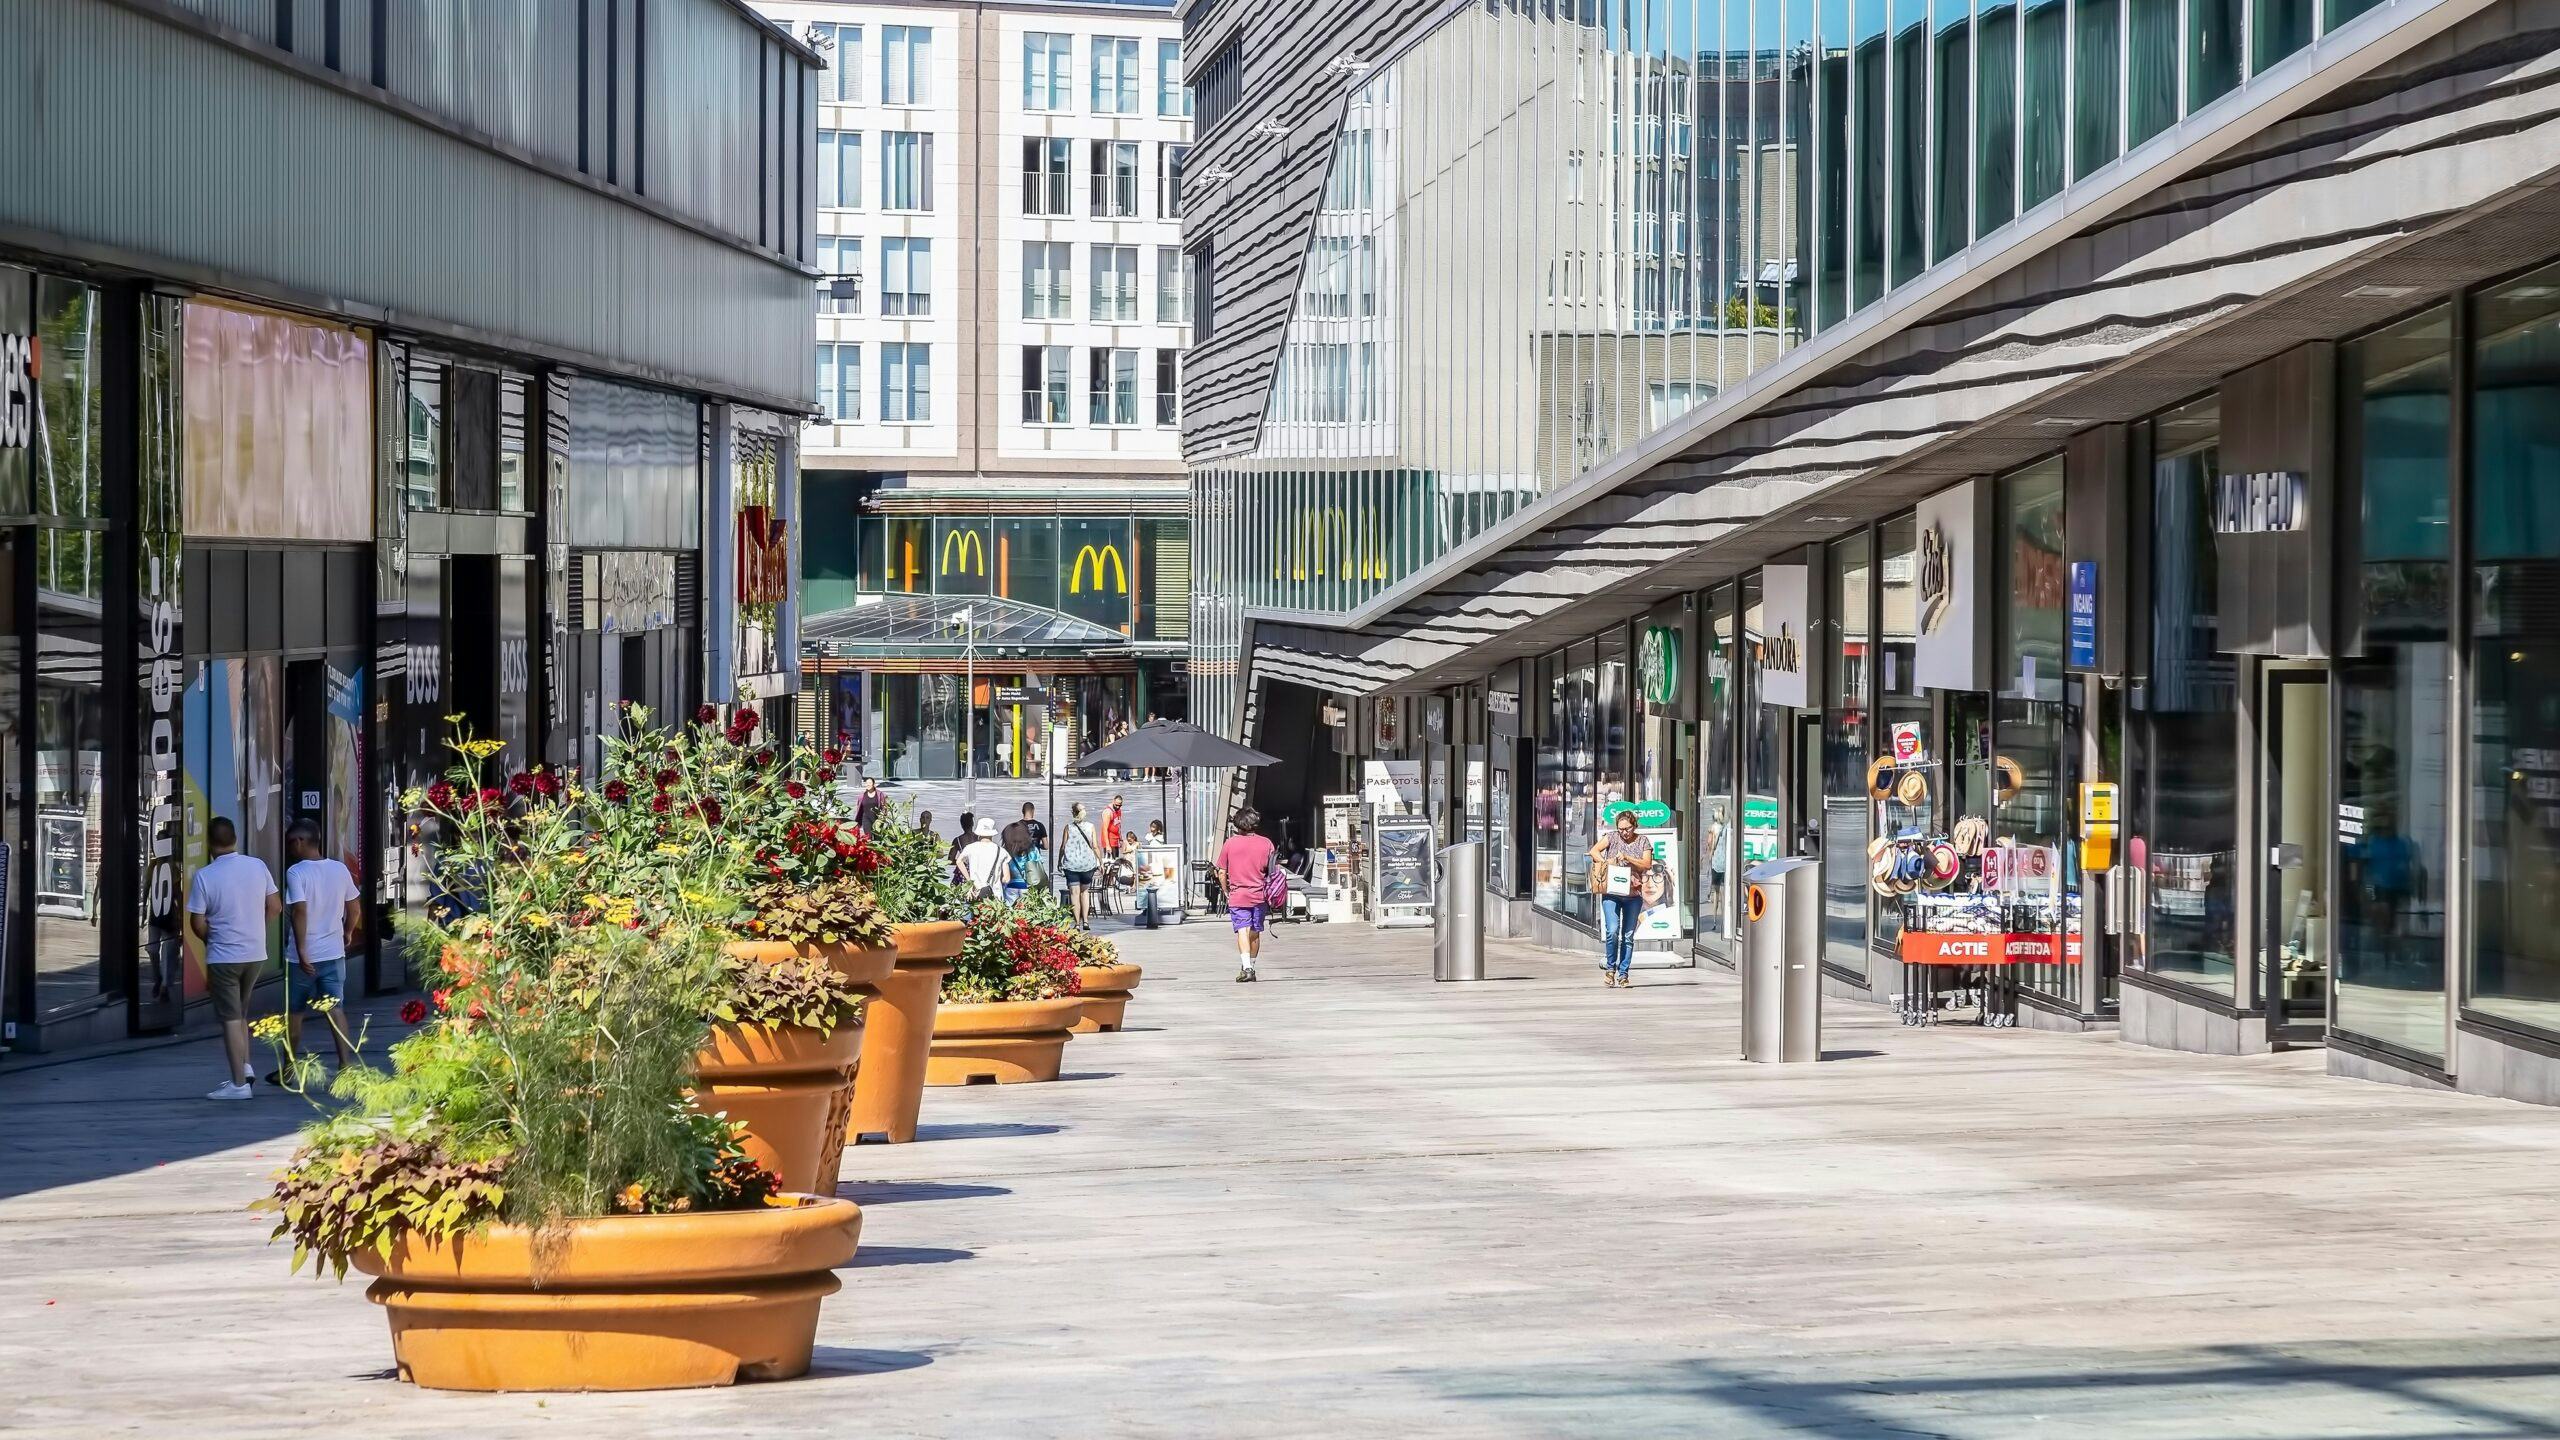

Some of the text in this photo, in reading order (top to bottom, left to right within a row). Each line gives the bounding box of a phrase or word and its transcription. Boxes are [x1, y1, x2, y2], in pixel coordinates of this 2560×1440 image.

[1762, 635, 1798, 674] PANDORA
[501, 639, 528, 693] BOSS
[406, 645, 440, 705] BOSS
[1366, 777, 1420, 786] PASFOTO'S
[304, 794, 317, 807] 10
[1609, 807, 1665, 819] Ssavers
[1938, 941, 1988, 956] ACTIE
